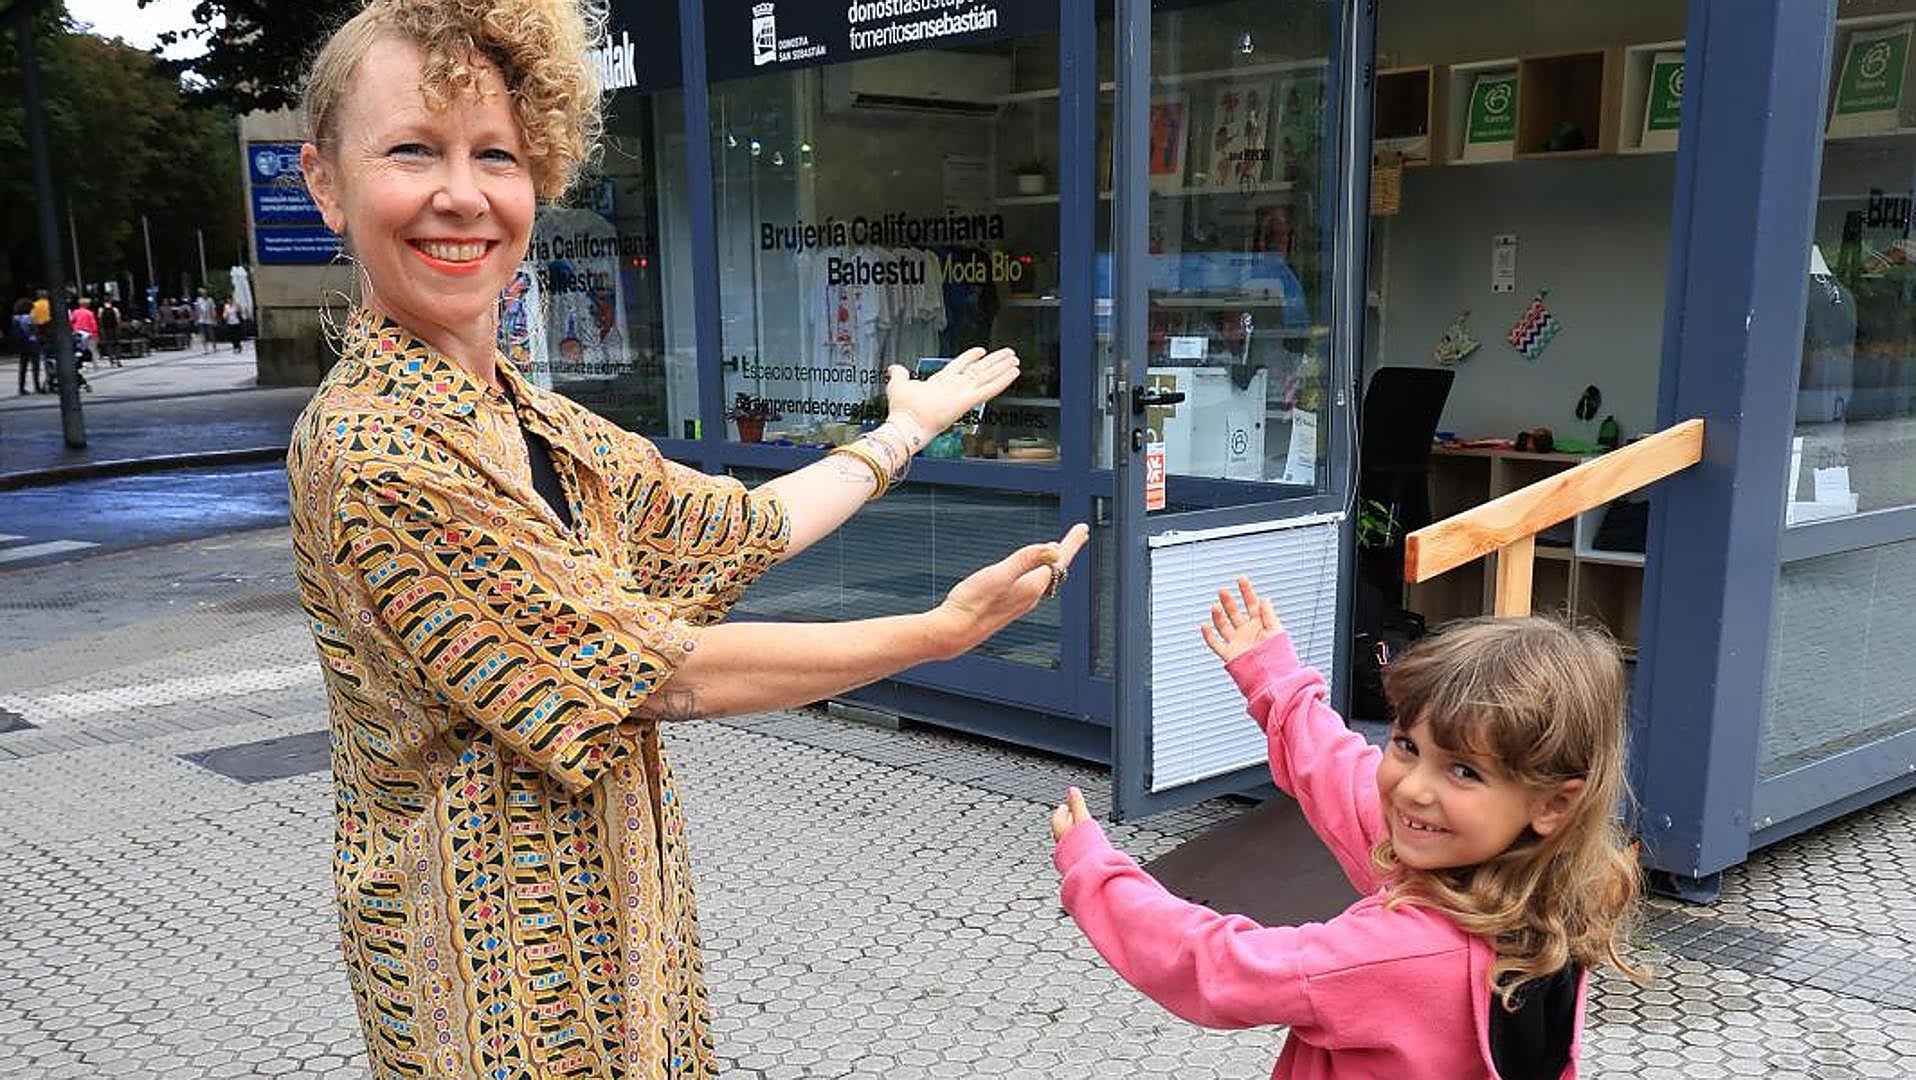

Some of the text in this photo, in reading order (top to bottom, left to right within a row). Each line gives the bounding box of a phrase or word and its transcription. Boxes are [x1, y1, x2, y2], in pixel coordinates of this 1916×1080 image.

[849, 4, 998, 50] fomentosansebastián
[778, 50, 791, 62] SAN
[760, 208, 1005, 254] Brujería Californiana
[827, 252, 1023, 286] Babestu Moda Bio
[743, 362, 792, 382] Espacio
[794, 364, 856, 386] temporal
